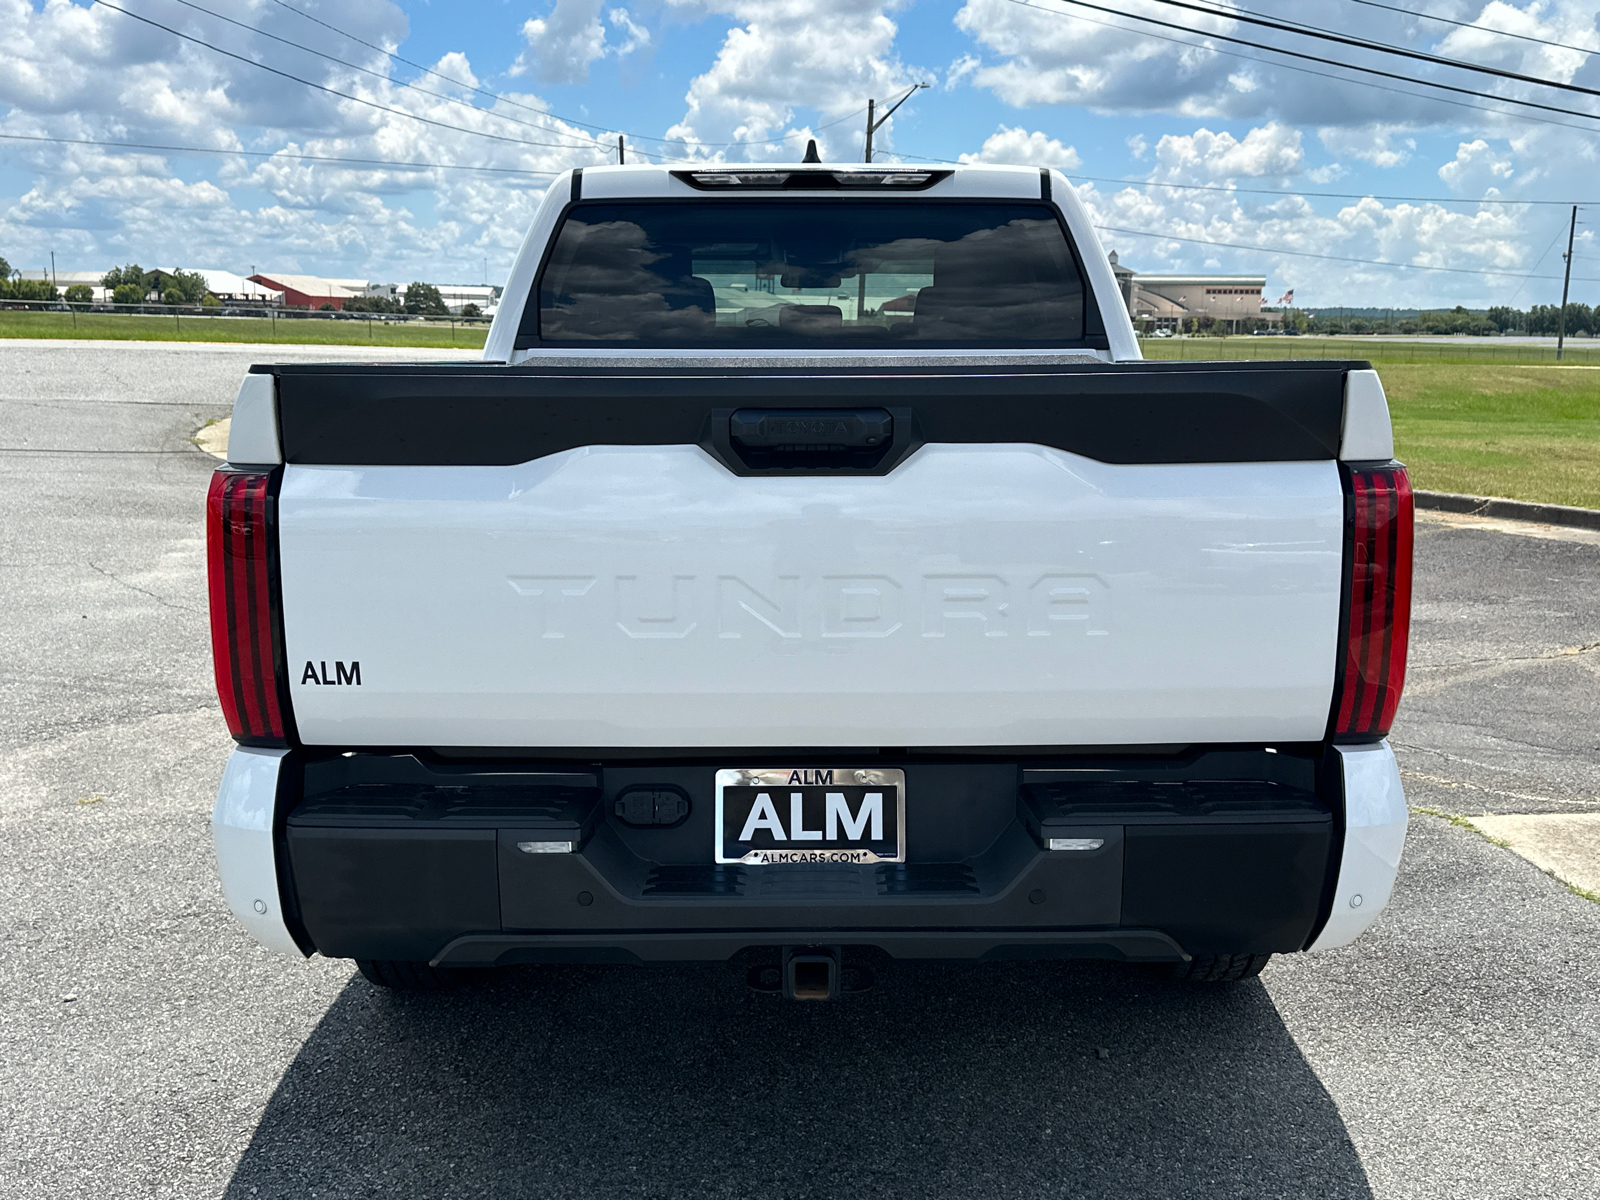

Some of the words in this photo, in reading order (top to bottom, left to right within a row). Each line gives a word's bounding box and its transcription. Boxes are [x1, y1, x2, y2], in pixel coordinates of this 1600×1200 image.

[774, 420, 848, 435] TOYOTA
[507, 573, 1111, 639] TUNDRA
[301, 661, 362, 686] ALM
[788, 769, 833, 785] ALM
[738, 792, 883, 841] ALM
[760, 852, 861, 864] ALMCARS.COM
